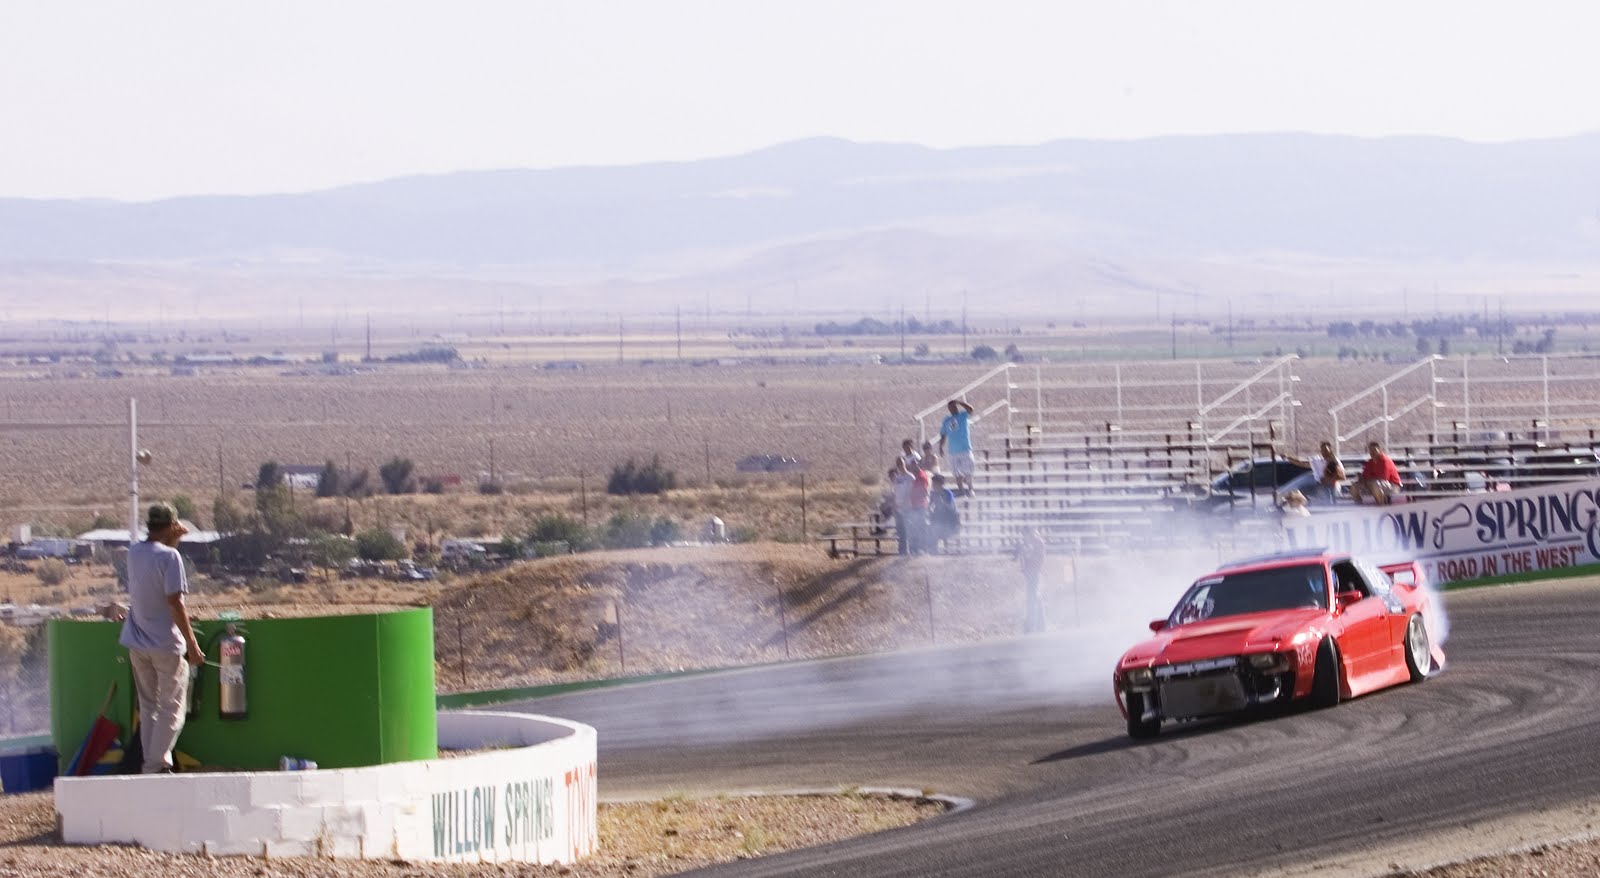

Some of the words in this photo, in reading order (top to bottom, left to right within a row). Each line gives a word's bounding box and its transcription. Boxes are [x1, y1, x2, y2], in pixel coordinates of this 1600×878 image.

[1437, 558, 1478, 581] ROAD
[1482, 554, 1498, 576] IN
[1502, 551, 1532, 574] THE
[1536, 545, 1585, 570] WEST"
[432, 785, 496, 857] WILLOW
